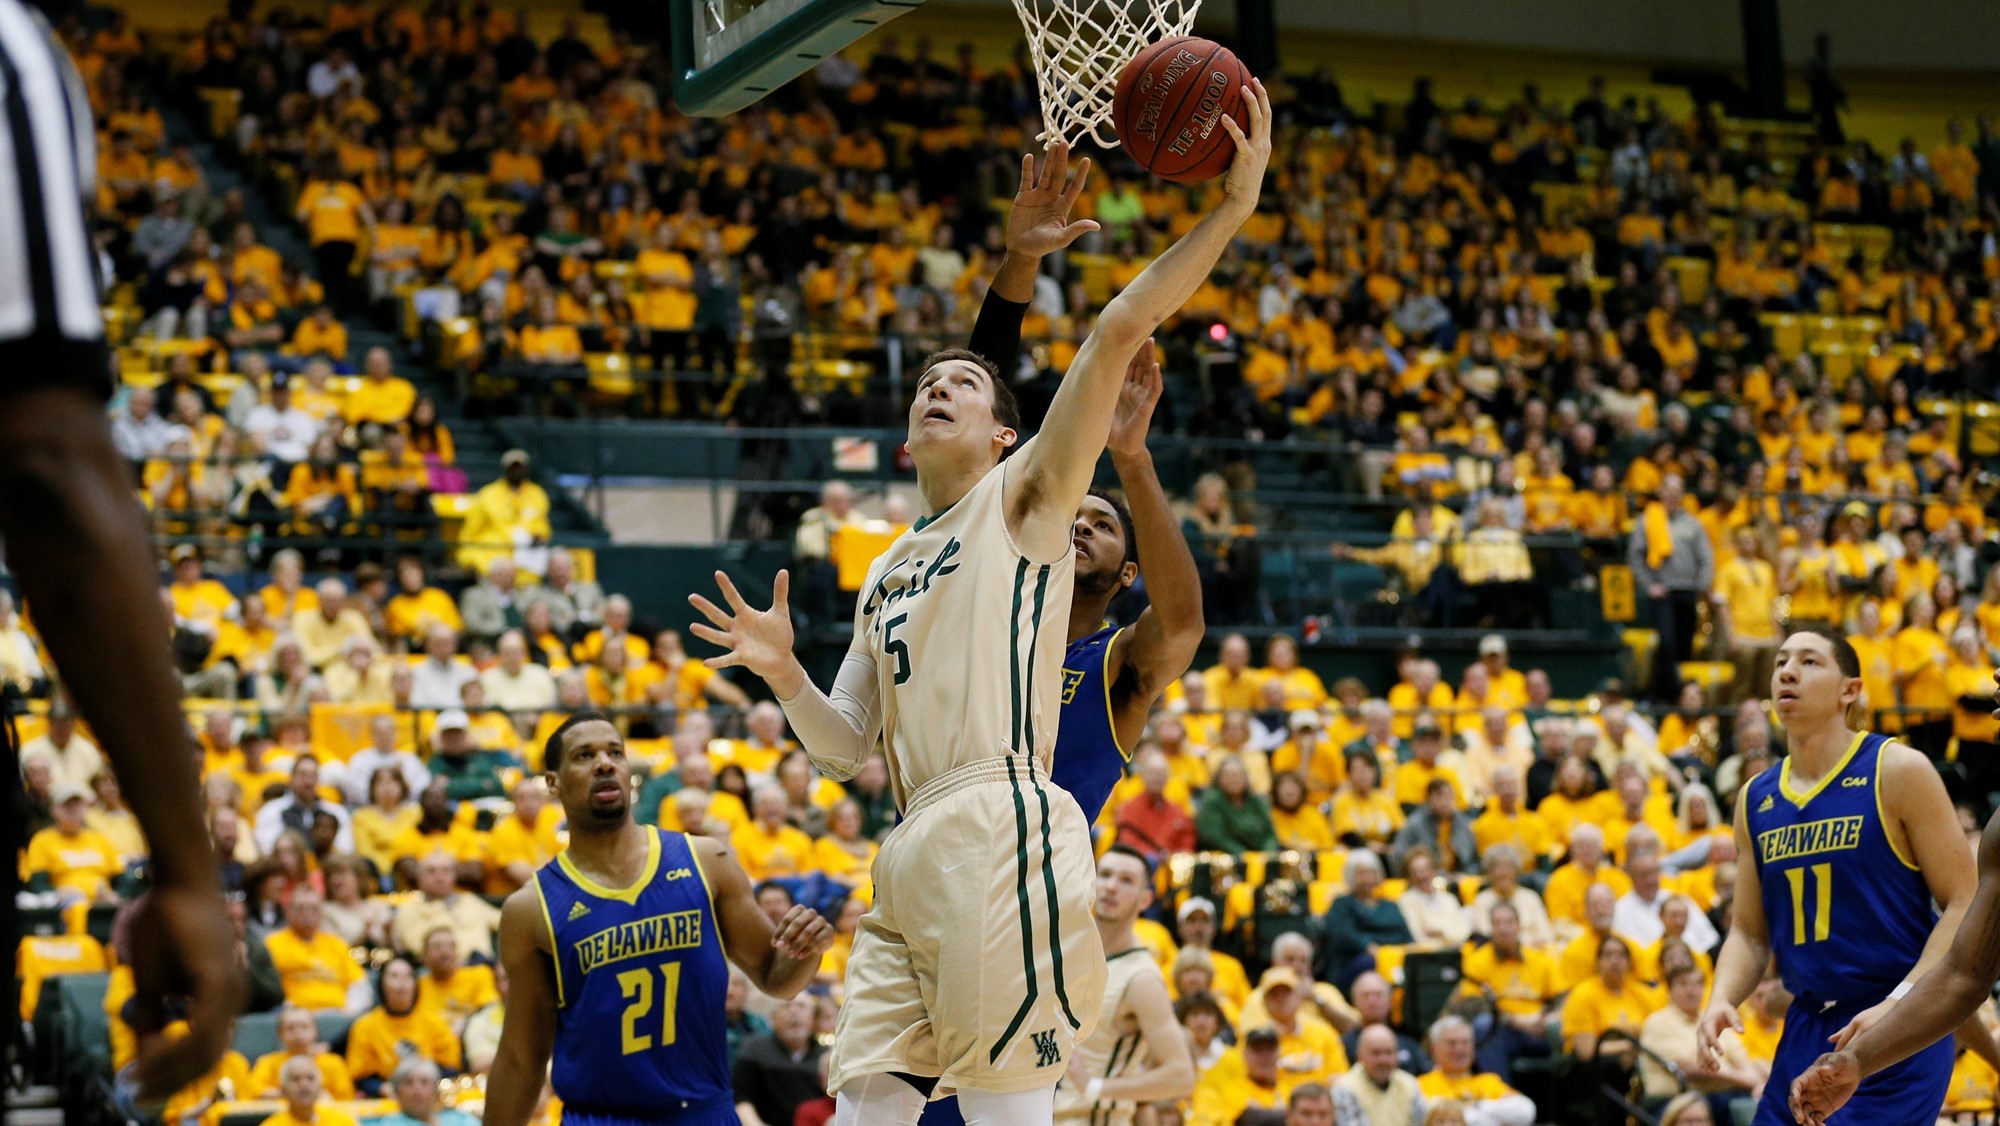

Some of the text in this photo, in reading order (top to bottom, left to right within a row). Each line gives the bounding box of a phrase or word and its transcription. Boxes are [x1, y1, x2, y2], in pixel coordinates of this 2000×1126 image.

[1136, 50, 1202, 141] SPALDING
[1169, 72, 1228, 155] TF-1000
[1200, 103, 1223, 139] LEGACY
[884, 612, 912, 686] 5
[1842, 777, 1867, 788] CAA
[666, 868, 692, 881] CAA
[1784, 862, 1832, 946] 11
[574, 909, 702, 975] DELAWARE
[616, 961, 681, 1056] 21
